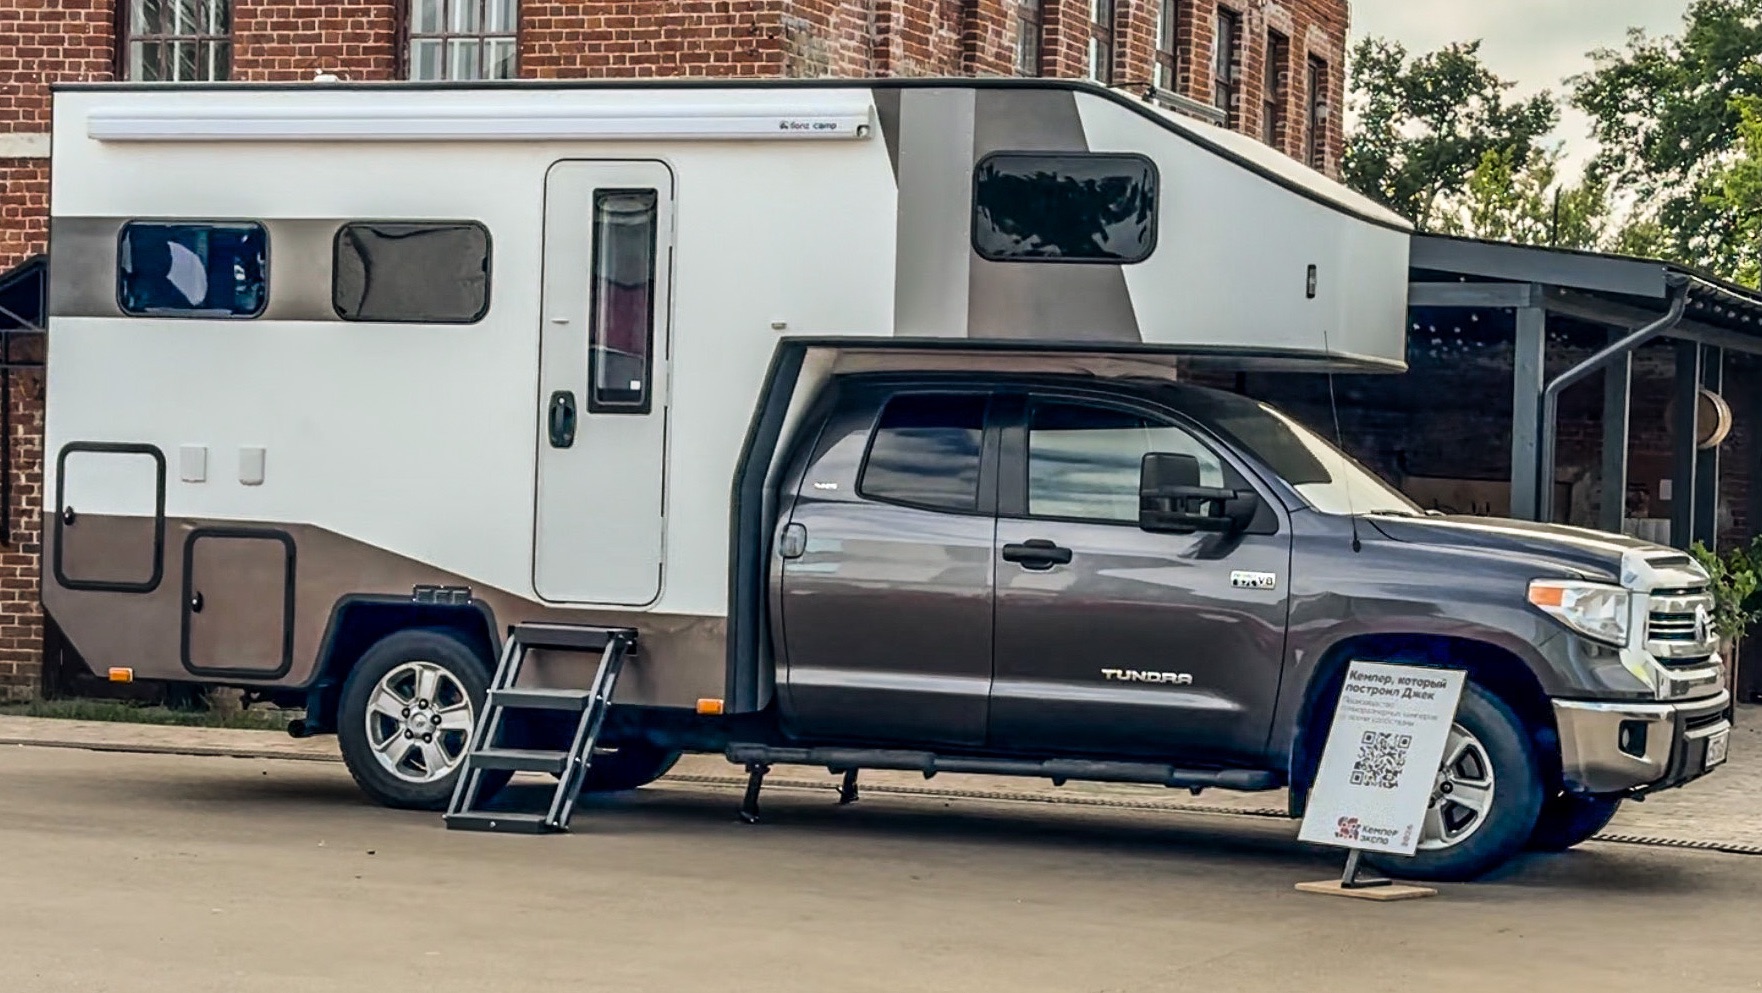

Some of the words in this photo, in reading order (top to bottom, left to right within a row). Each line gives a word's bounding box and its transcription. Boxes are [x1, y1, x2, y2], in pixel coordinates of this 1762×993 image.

[1101, 668, 1193, 685] TUNDRA
[1349, 670, 1395, 685] Кемпер,
[1398, 676, 1448, 690] который
[1345, 683, 1400, 696] построил
[1402, 687, 1435, 700] Джек
[1362, 825, 1398, 837] Кемпер
